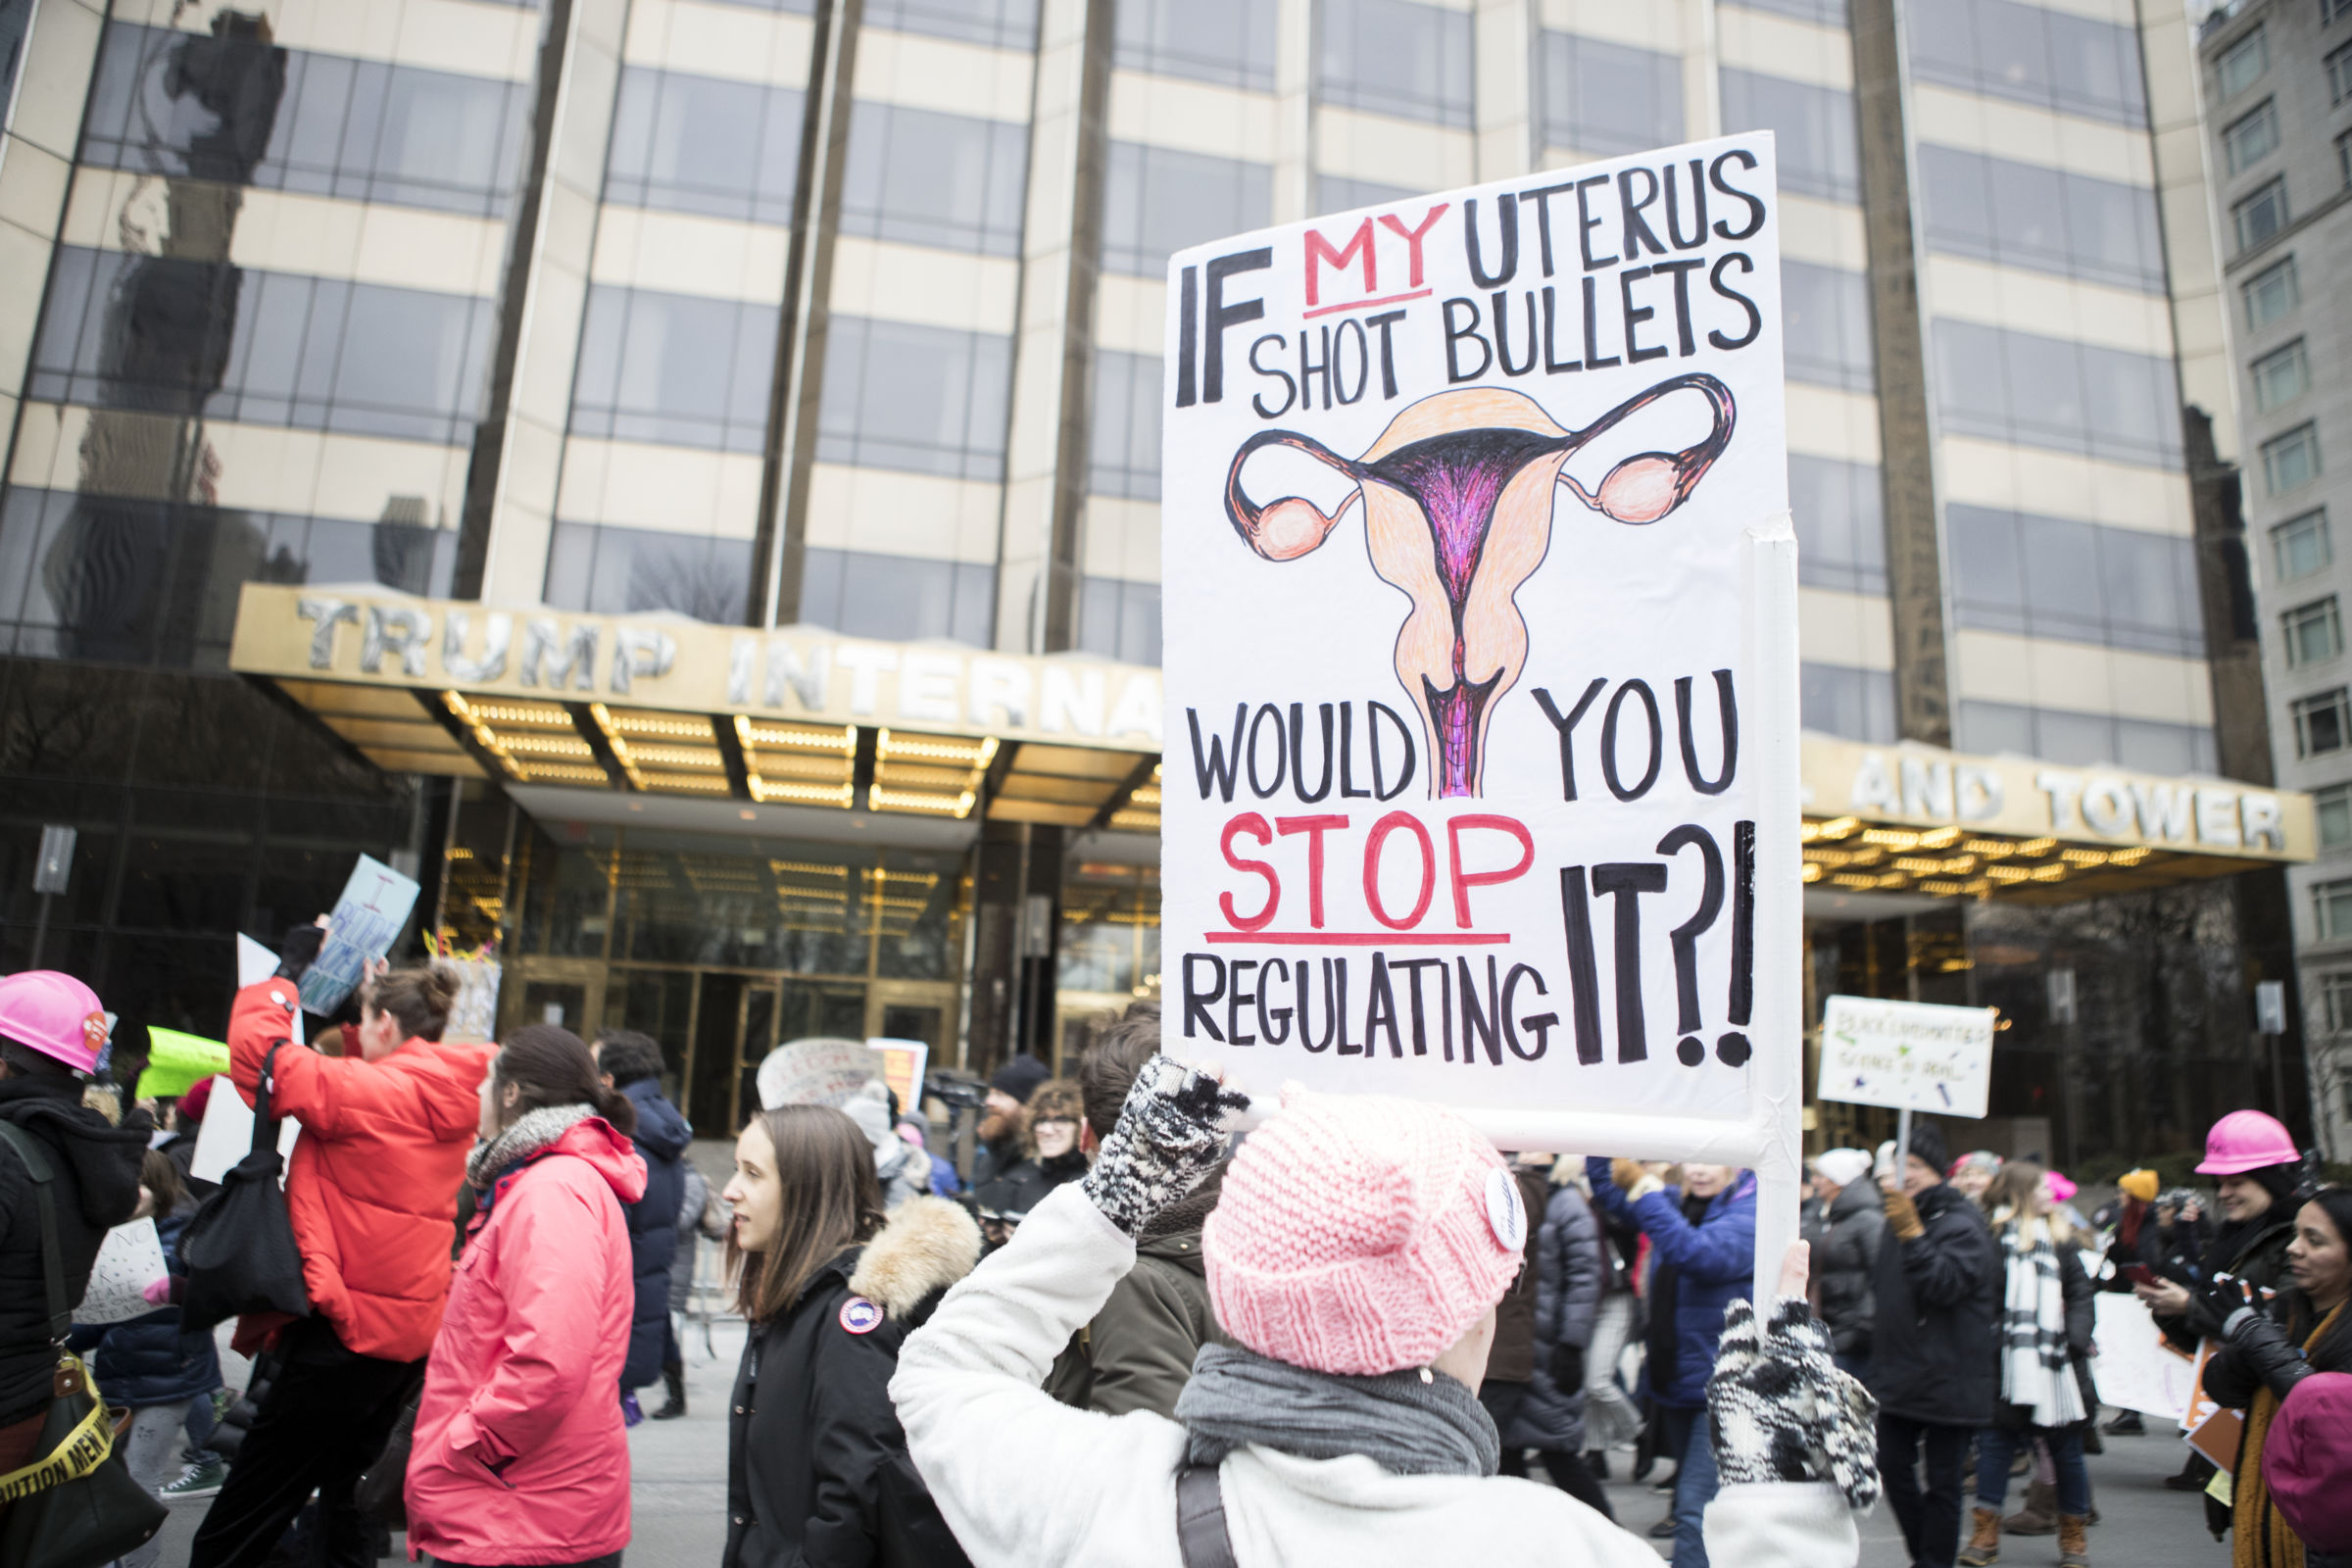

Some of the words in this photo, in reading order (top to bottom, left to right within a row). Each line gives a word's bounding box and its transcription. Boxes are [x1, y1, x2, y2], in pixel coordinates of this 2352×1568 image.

[1175, 247, 1272, 408] IF
[1302, 202, 1450, 307] MY
[1463, 149, 1766, 289] UTERUS
[1249, 309, 1407, 419] SHOT
[1441, 251, 1762, 384] BULLETS
[296, 598, 677, 694] TRUMP
[1850, 753, 2005, 821] AND
[2035, 768, 2286, 851] TOWER
[1186, 699, 1416, 804] WOULD
[1530, 668, 1739, 804] YOU
[1182, 952, 1559, 1067] REGULATING
[1559, 819, 1756, 1068] IT?!
[1218, 810, 1536, 932] STOP
[67, 1428, 105, 1476] MEN
